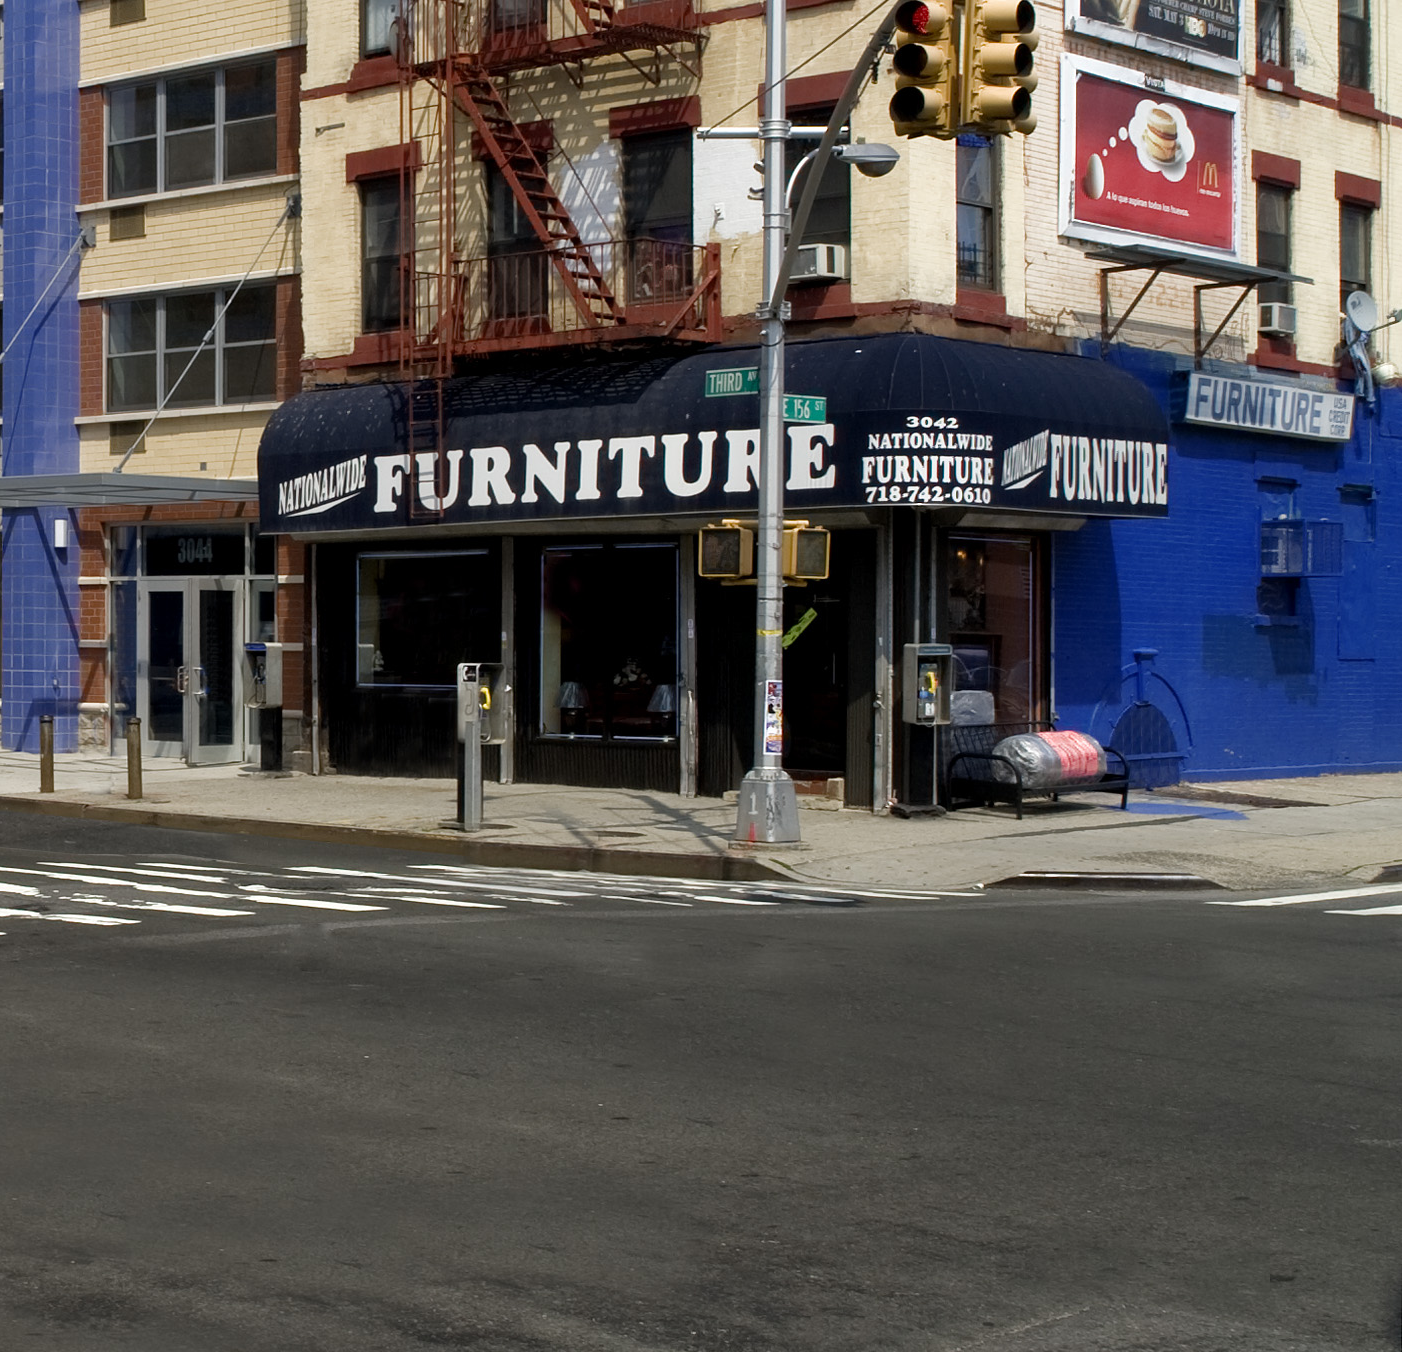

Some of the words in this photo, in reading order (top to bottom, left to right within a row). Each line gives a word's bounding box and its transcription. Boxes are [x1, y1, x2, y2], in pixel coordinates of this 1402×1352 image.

[1106, 191, 1111, 200] A
[1112, 192, 1117, 201] lo
[1117, 195, 1128, 204] que
[1148, 200, 1162, 210] todos
[709, 372, 743, 393] THIRD
[782, 398, 789, 417] E
[794, 399, 810, 418] 156
[815, 401, 824, 411] ST
[1195, 377, 1323, 434] FURNITURE
[1334, 397, 1347, 410] USA
[906, 416, 959, 429] 3042
[1329, 410, 1350, 425] CREDIT
[868, 432, 993, 451] NATIONALWIDE
[278, 454, 367, 516] NATIONALWIDE
[373, 423, 836, 513] FURNITURE
[861, 455, 994, 486] FURNITURE
[1049, 433, 1168, 505] FURNITURE
[865, 485, 991, 504] 718-742-0610
[178, 537, 213, 563] 3044
